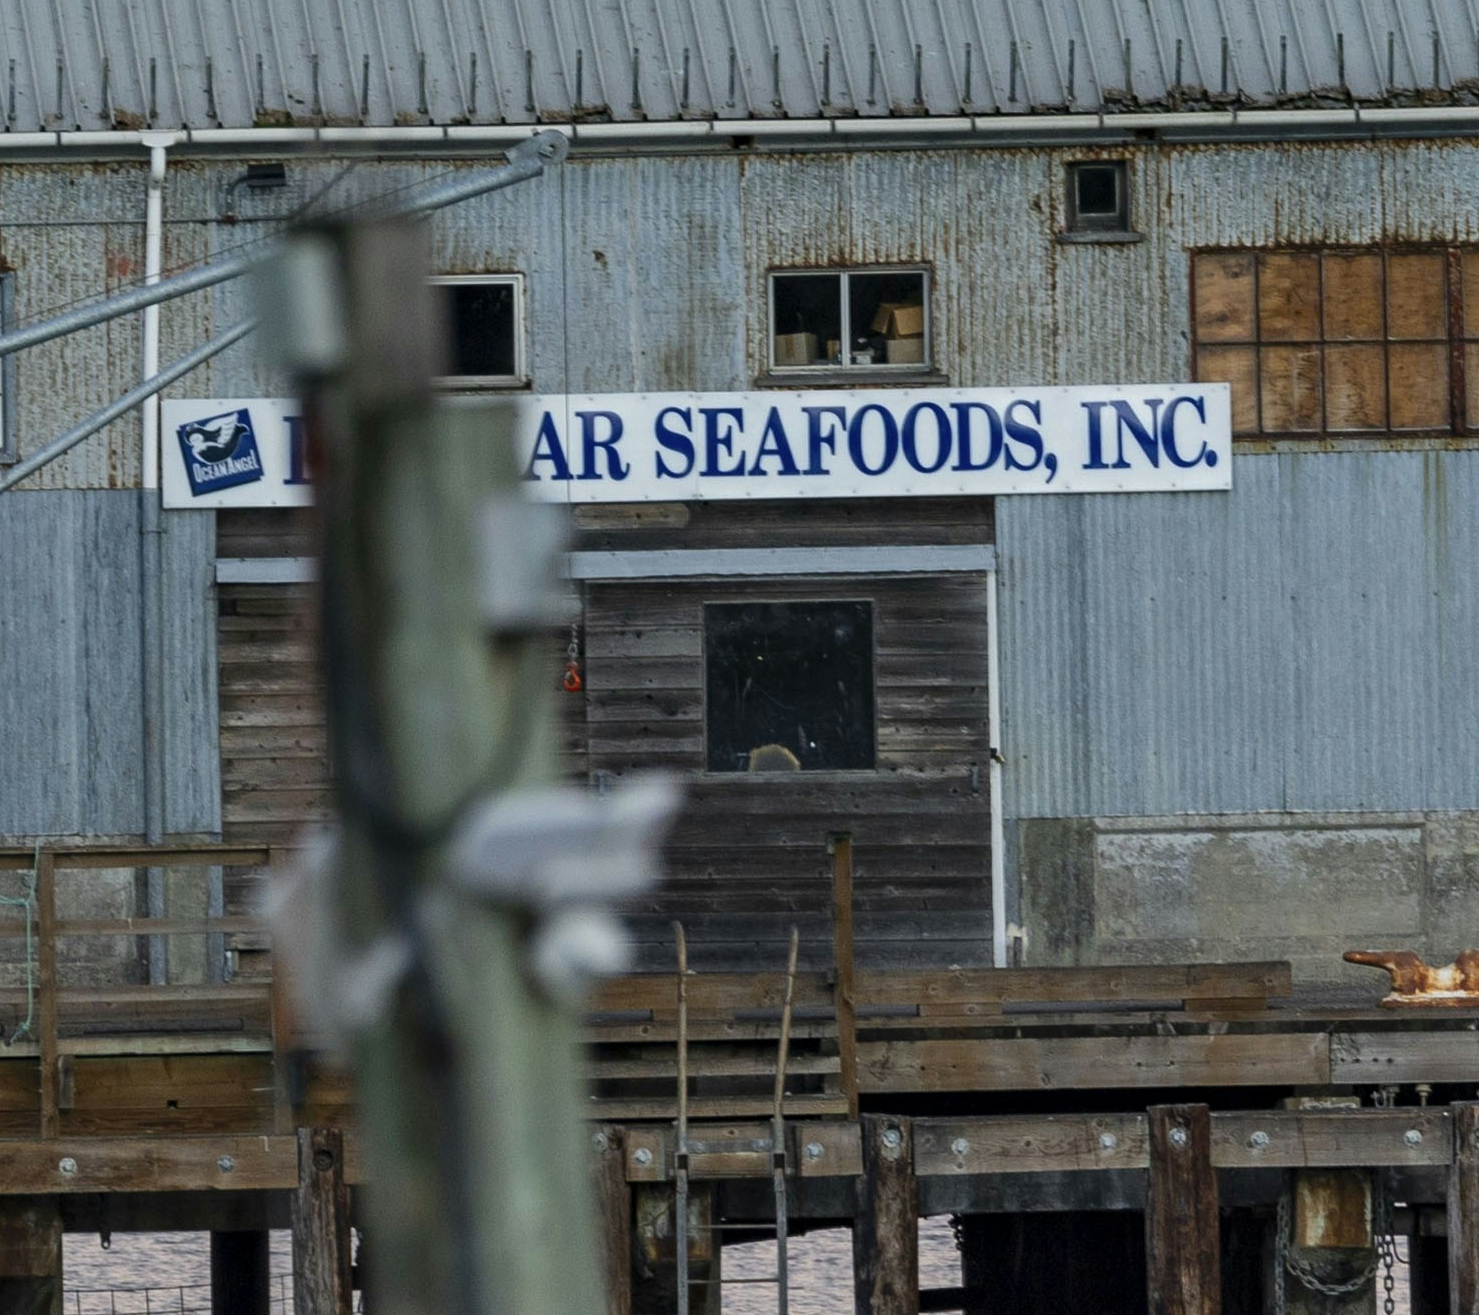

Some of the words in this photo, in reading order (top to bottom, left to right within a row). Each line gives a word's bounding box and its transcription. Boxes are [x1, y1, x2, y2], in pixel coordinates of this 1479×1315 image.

[523, 409, 631, 482] AR
[653, 400, 1059, 484] SEAFOODS,
[1080, 395, 1219, 470] INC.
